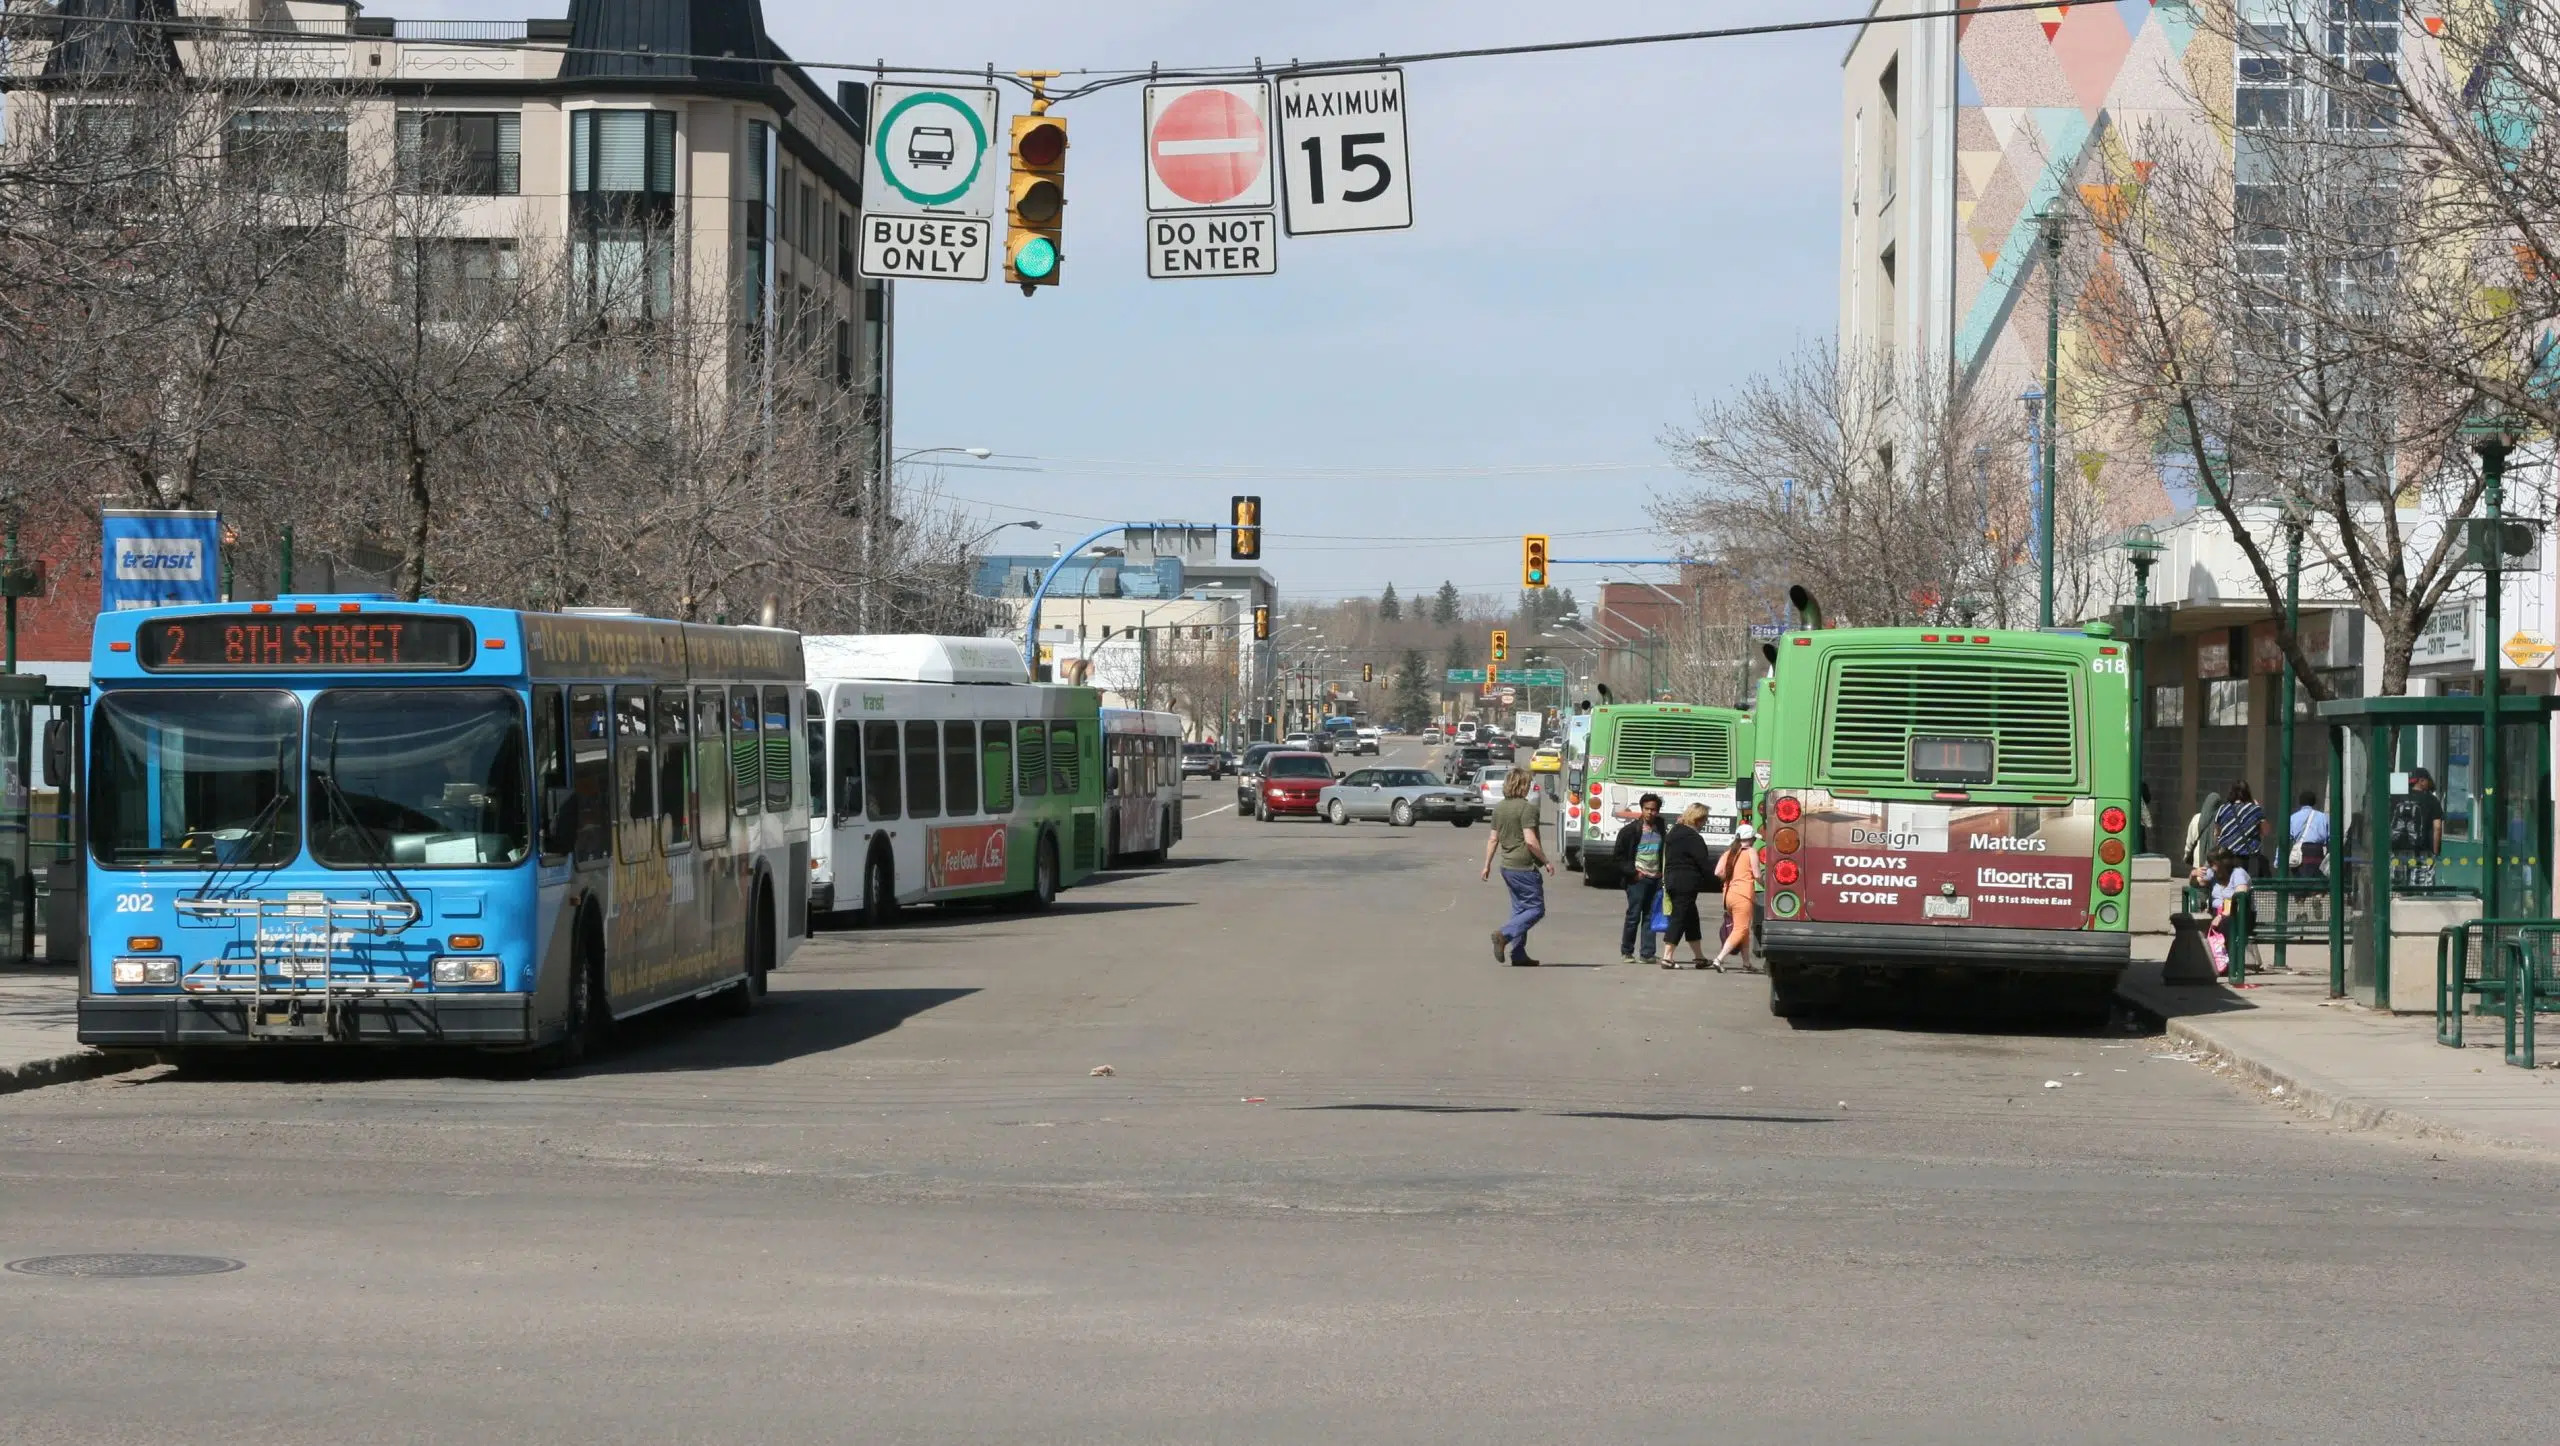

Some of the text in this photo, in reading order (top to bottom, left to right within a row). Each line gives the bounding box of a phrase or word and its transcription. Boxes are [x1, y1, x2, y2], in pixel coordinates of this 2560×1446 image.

[1285, 89, 1400, 120] MAXIMUM
[1301, 132, 1392, 205] 15
[873, 221, 979, 249] BUSES
[1157, 220, 1265, 246] DO NOT
[882, 246, 967, 274] ONLY
[1164, 246, 1261, 271] ENTER
[122, 550, 197, 569] transit
[166, 624, 403, 664] 2 8TH STREET
[540, 619, 581, 662] Now
[586, 622, 643, 675] bigger
[712, 638, 737, 672] you
[2092, 658, 2124, 674] 618
[1943, 743, 1962, 769] 11
[1850, 828, 2047, 852] Design Matters
[1832, 854, 1907, 869] TODAYS
[1820, 872, 1918, 889] FLOORING
[1979, 868, 2072, 890] floorit.ca
[116, 894, 154, 913] 202
[1838, 891, 1899, 905] STORE
[1977, 895, 2072, 906] 418 51st Street East
